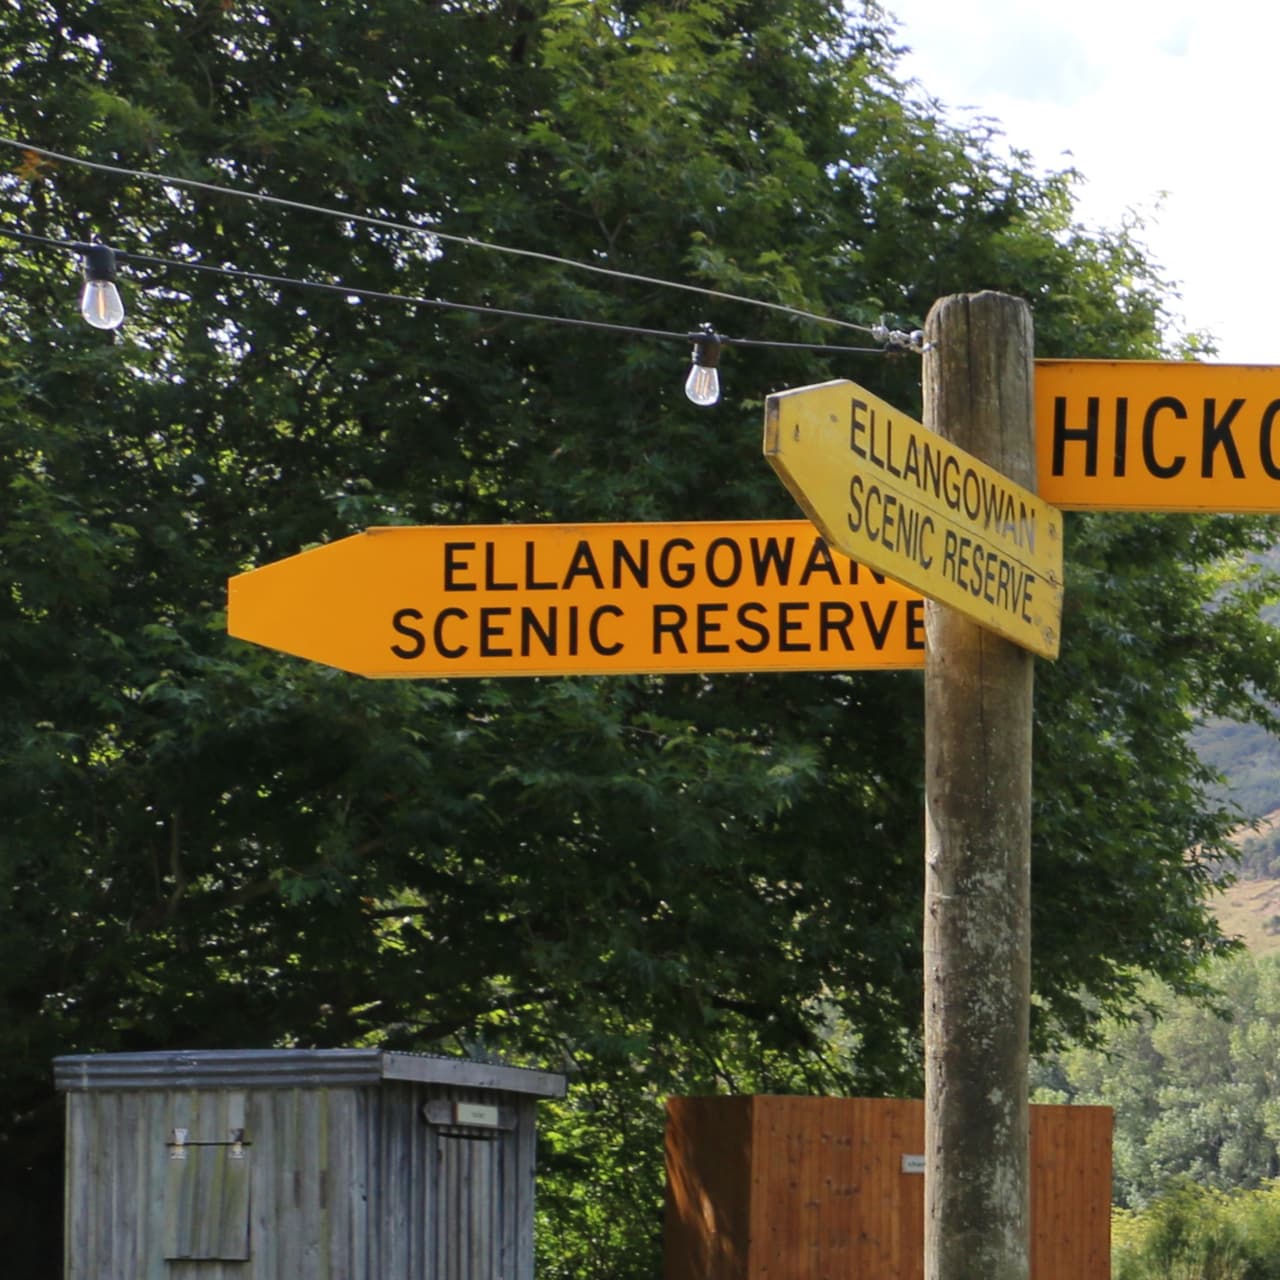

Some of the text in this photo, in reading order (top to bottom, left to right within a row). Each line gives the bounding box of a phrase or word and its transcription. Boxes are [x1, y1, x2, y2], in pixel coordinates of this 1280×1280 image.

[848, 474, 1036, 624] SCENIC RESERVE
[850, 398, 1036, 555] ELLANGOWAN
[393, 601, 925, 658] SCENIC RESERVE
